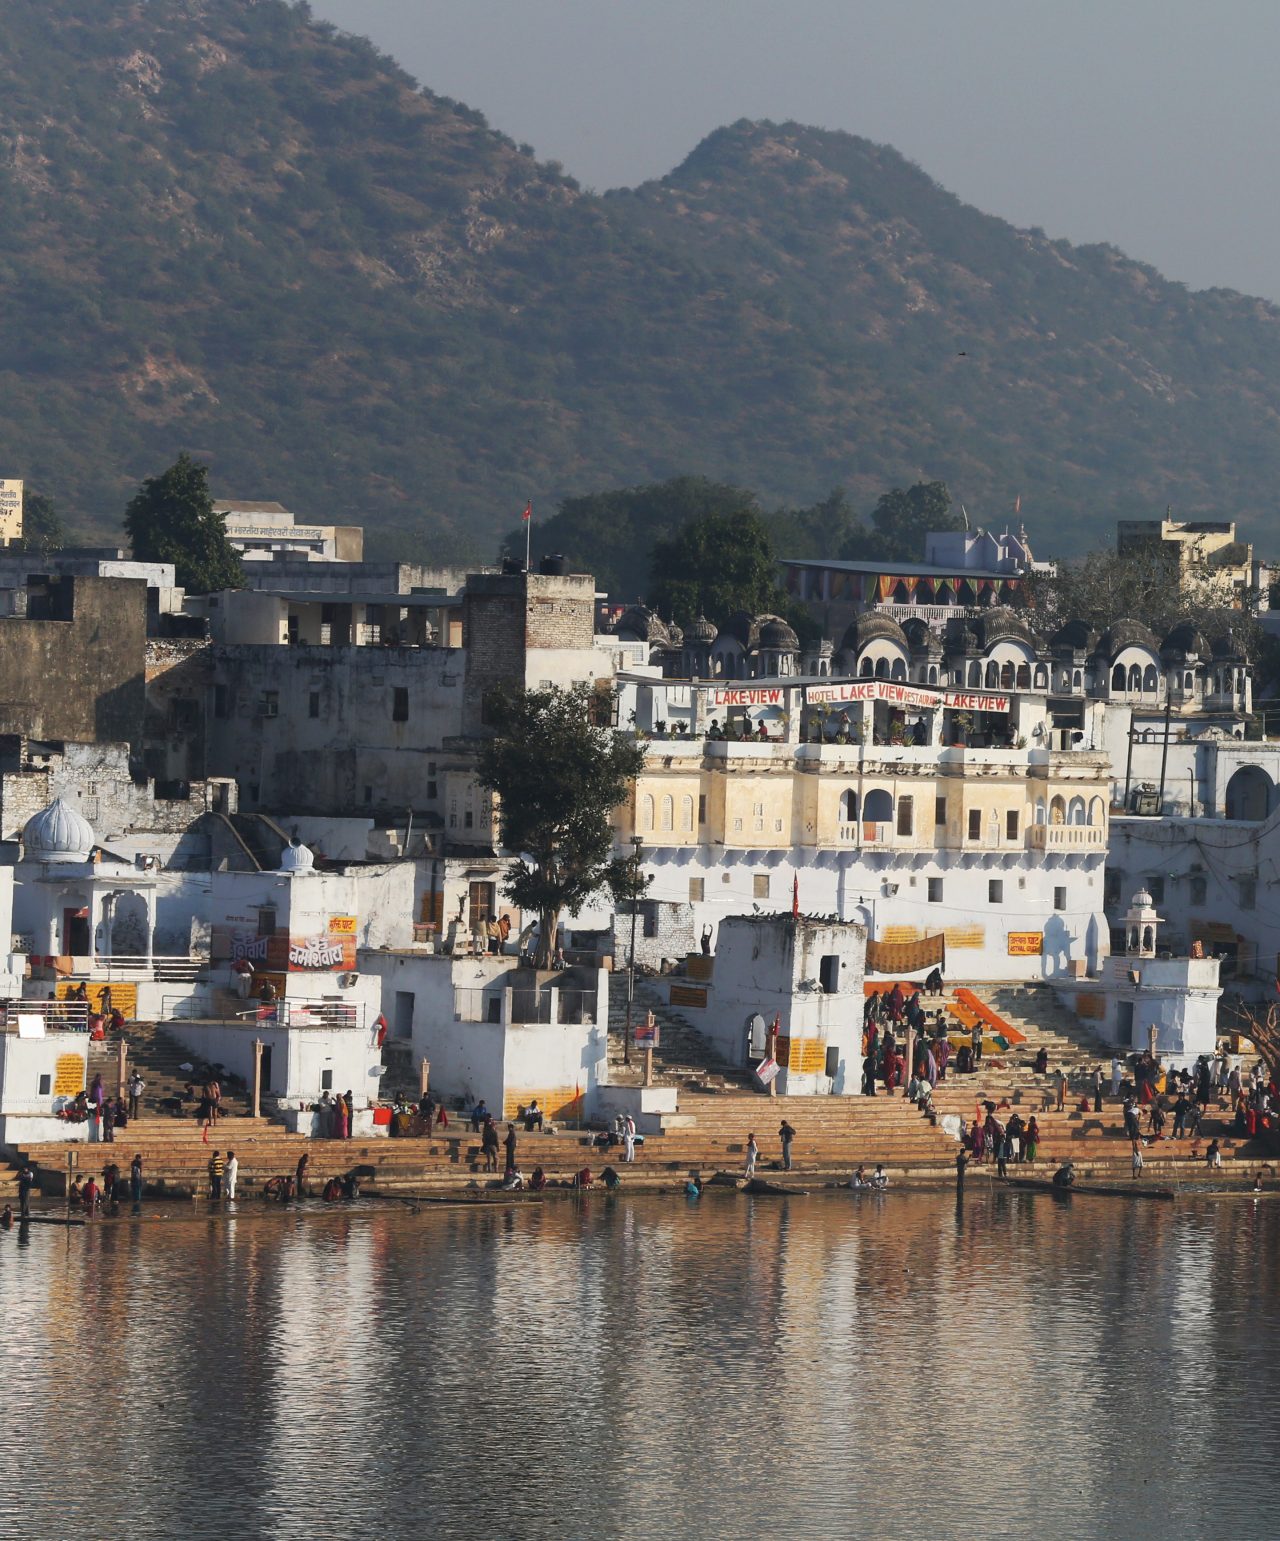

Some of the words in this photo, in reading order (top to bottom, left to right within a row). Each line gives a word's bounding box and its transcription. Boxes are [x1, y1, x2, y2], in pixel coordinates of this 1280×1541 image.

[808, 689, 838, 703] HOTEL
[841, 684, 875, 700] LAKE
[878, 683, 905, 700] VIEW
